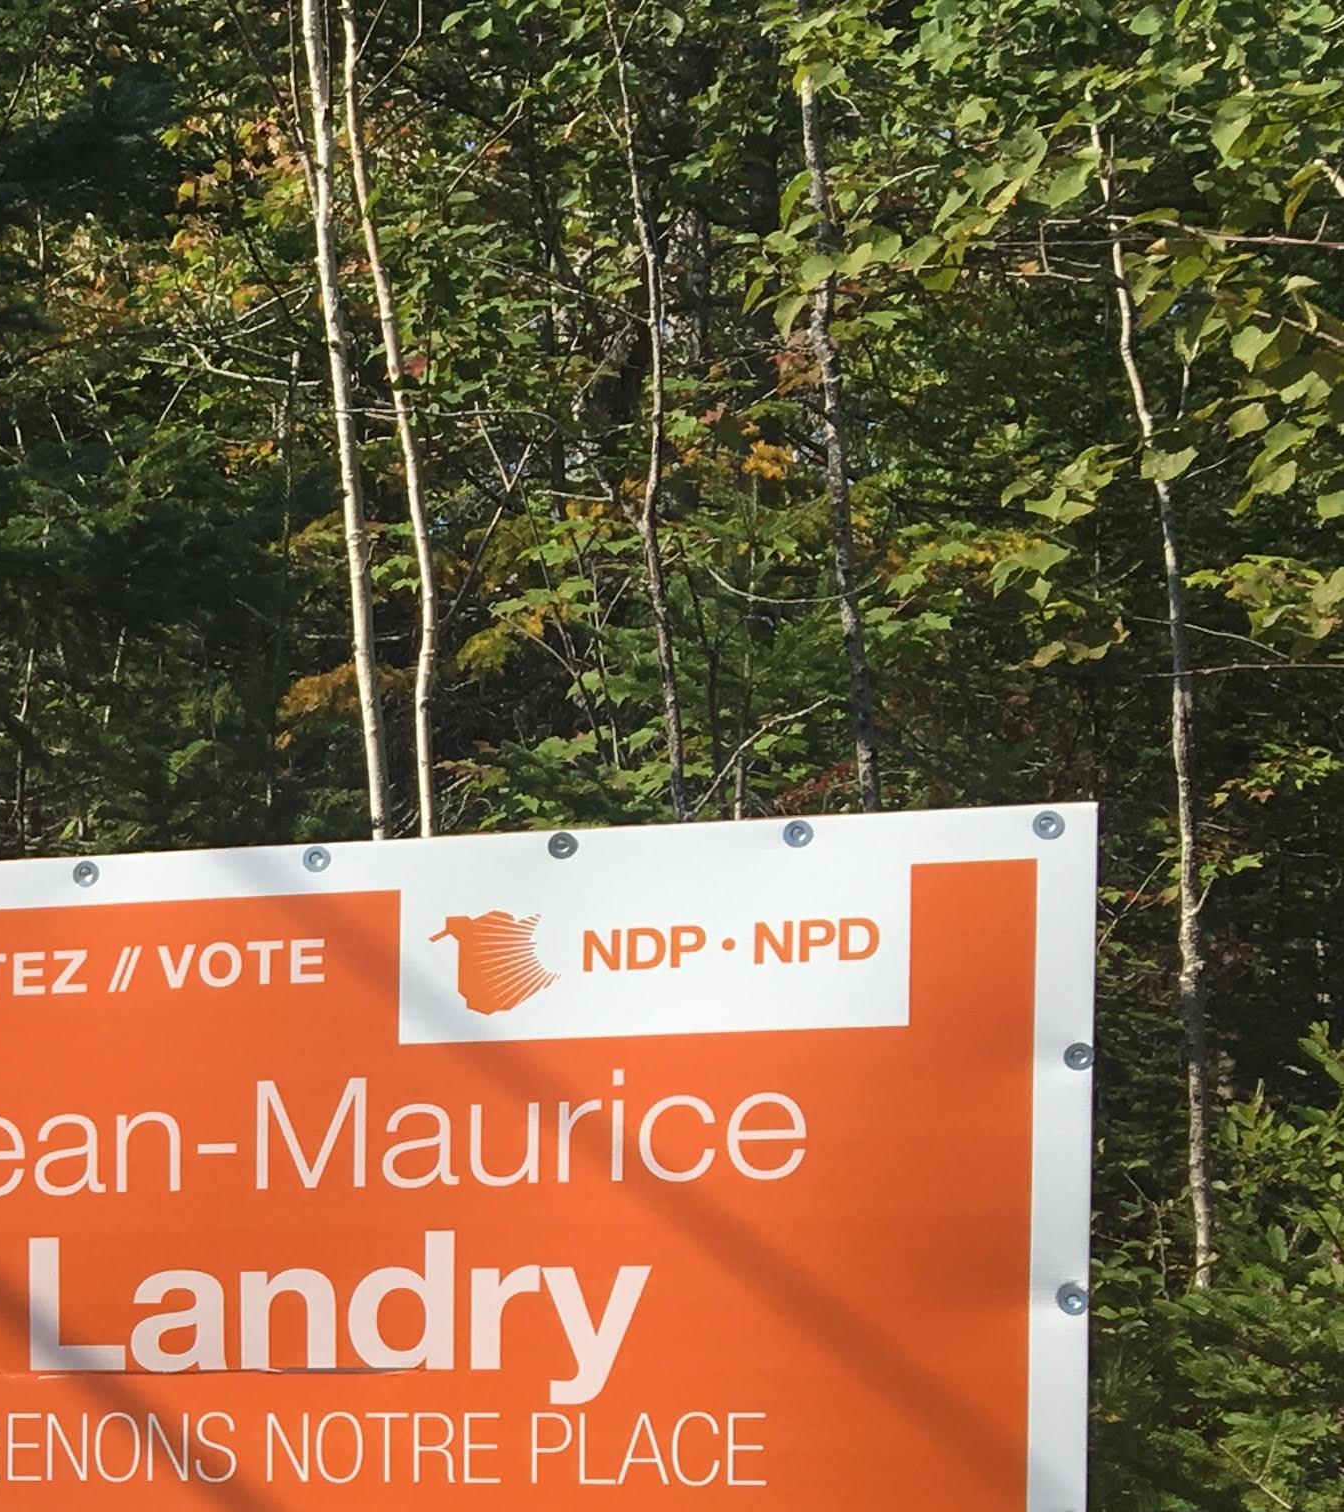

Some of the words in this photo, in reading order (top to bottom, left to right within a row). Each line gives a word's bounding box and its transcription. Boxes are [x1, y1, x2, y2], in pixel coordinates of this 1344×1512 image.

[156, 938, 327, 990] VOTE
[581, 925, 707, 974] NDP
[753, 916, 882, 967] NPD
[29, 1229, 653, 1405] Landry
[266, 1412, 501, 1485] NOTRE
[530, 1411, 768, 1487] PLACE
